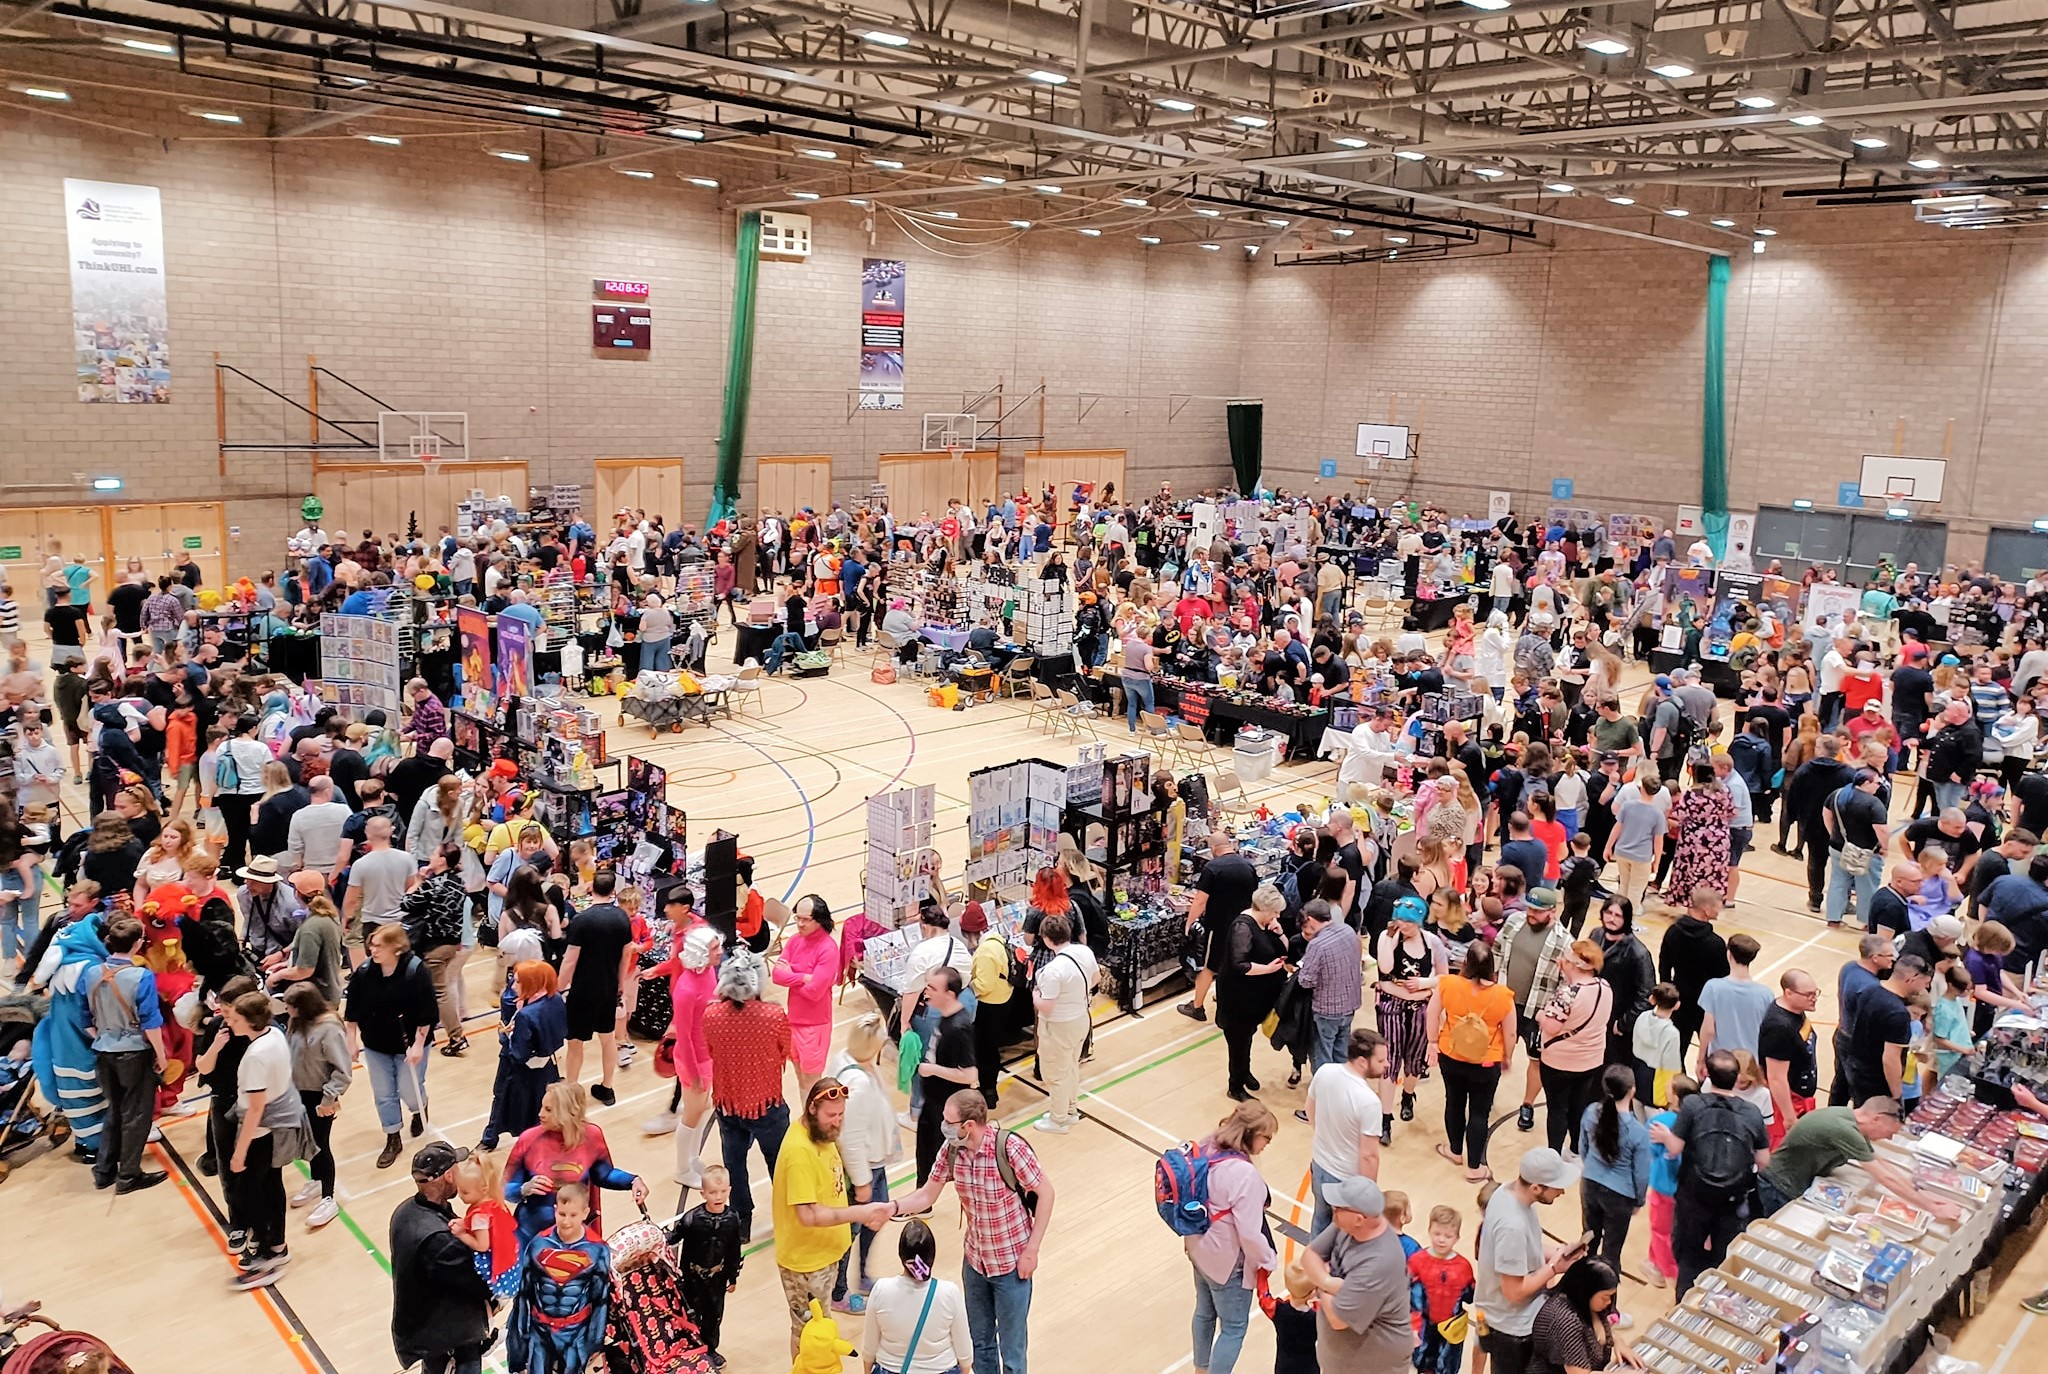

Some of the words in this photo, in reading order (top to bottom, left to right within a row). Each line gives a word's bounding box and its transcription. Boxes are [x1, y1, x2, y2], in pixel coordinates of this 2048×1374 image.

[77, 260, 158, 275] ThinkUHI.com
[1845, 491, 1857, 504] 7
[1179, 702, 1210, 717] TRAVEL
